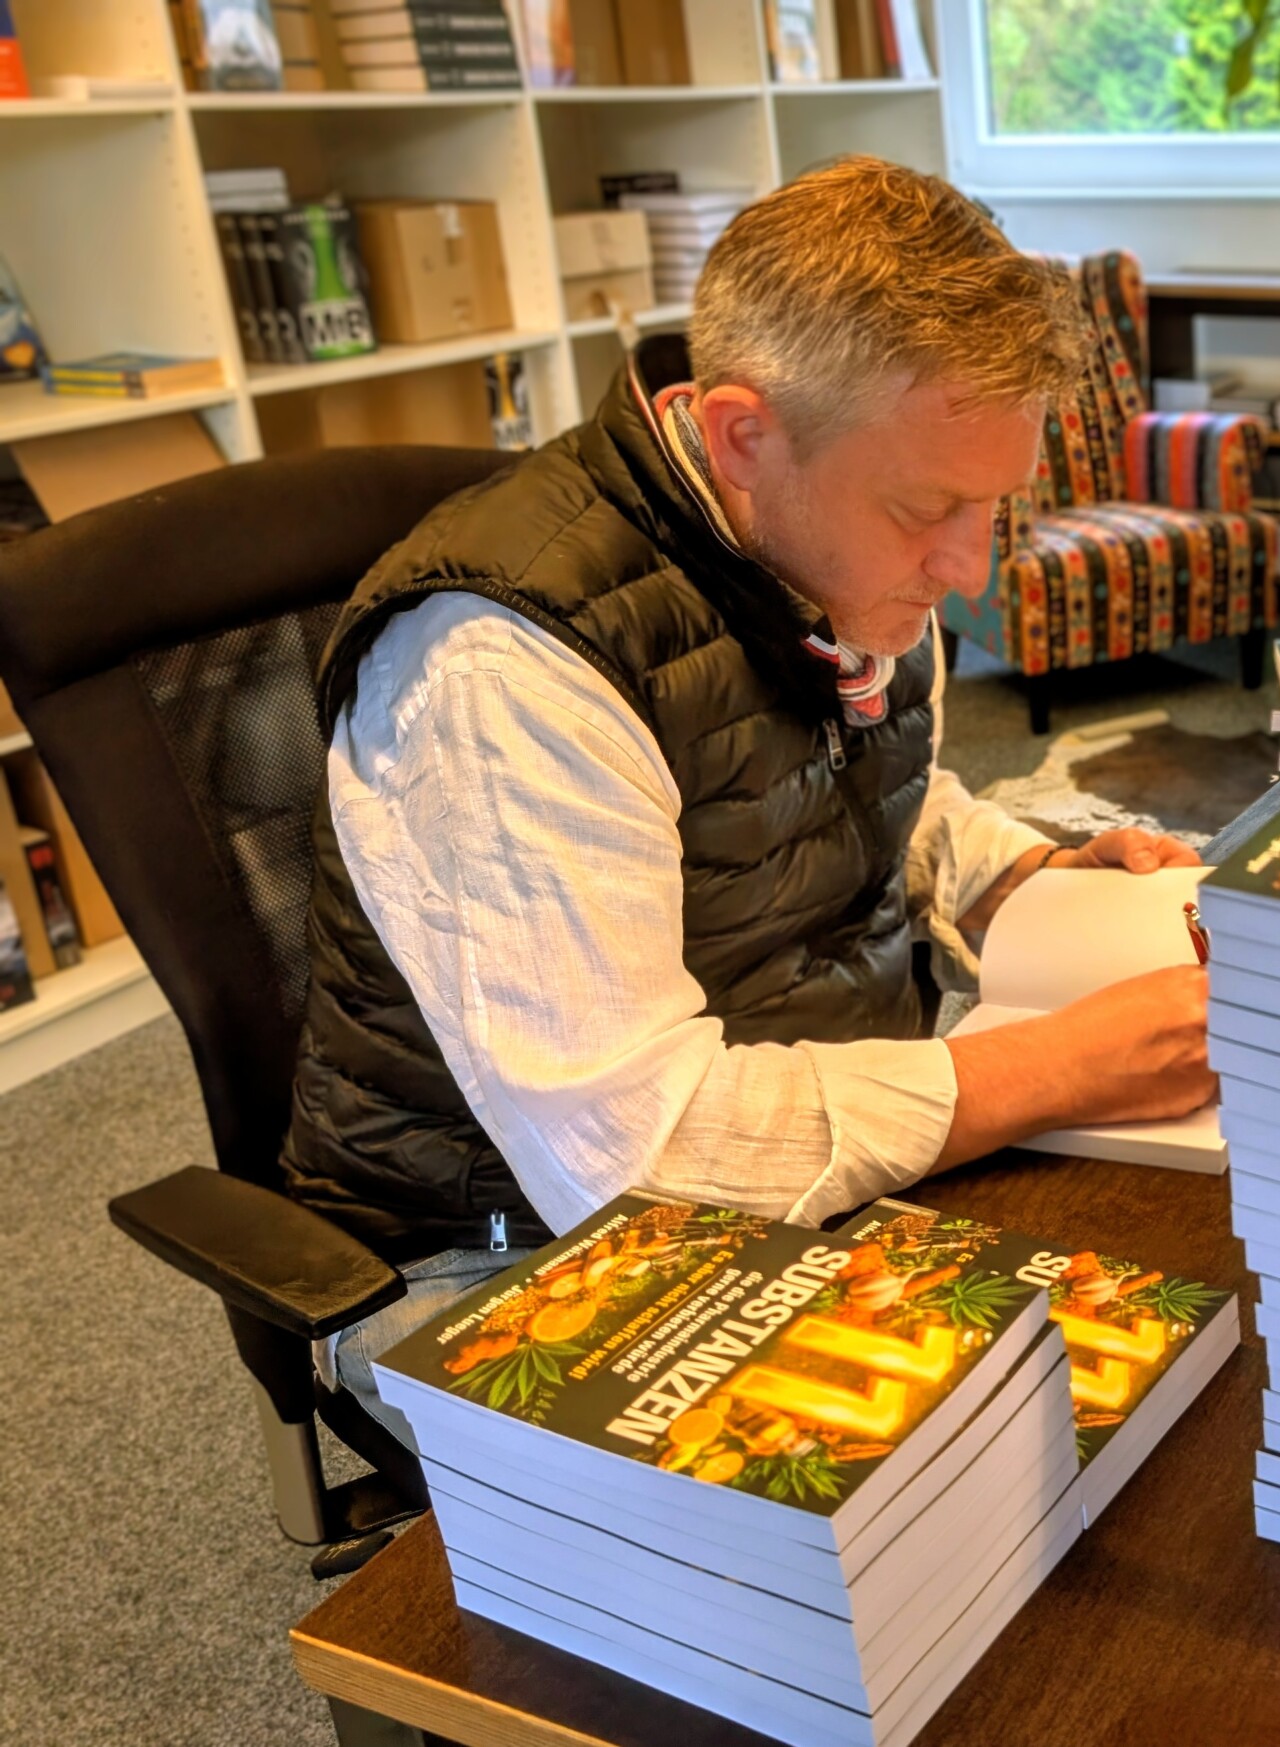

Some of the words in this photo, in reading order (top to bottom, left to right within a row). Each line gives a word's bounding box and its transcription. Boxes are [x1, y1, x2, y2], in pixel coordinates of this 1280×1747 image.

[589, 1213, 629, 1241] Alfred
[851, 1219, 883, 1241] Alfred
[711, 1250, 735, 1265] Es
[687, 1263, 717, 1284] aber
[705, 1268, 742, 1295] gerne
[739, 1271, 764, 1288] die
[478, 1284, 524, 1315] Jürgen
[657, 1282, 691, 1309] nicht
[721, 1286, 746, 1304] die
[436, 1311, 485, 1346] Lueger
[603, 1306, 660, 1350] schaffen
[651, 1294, 711, 1341] verbieten
[605, 1245, 852, 1446] SUBSTANZEN
[611, 1340, 658, 1375] würde
[626, 1303, 730, 1383] Pharmaindustrie
[568, 1348, 608, 1381] wird!
[726, 1314, 956, 1438] 77
